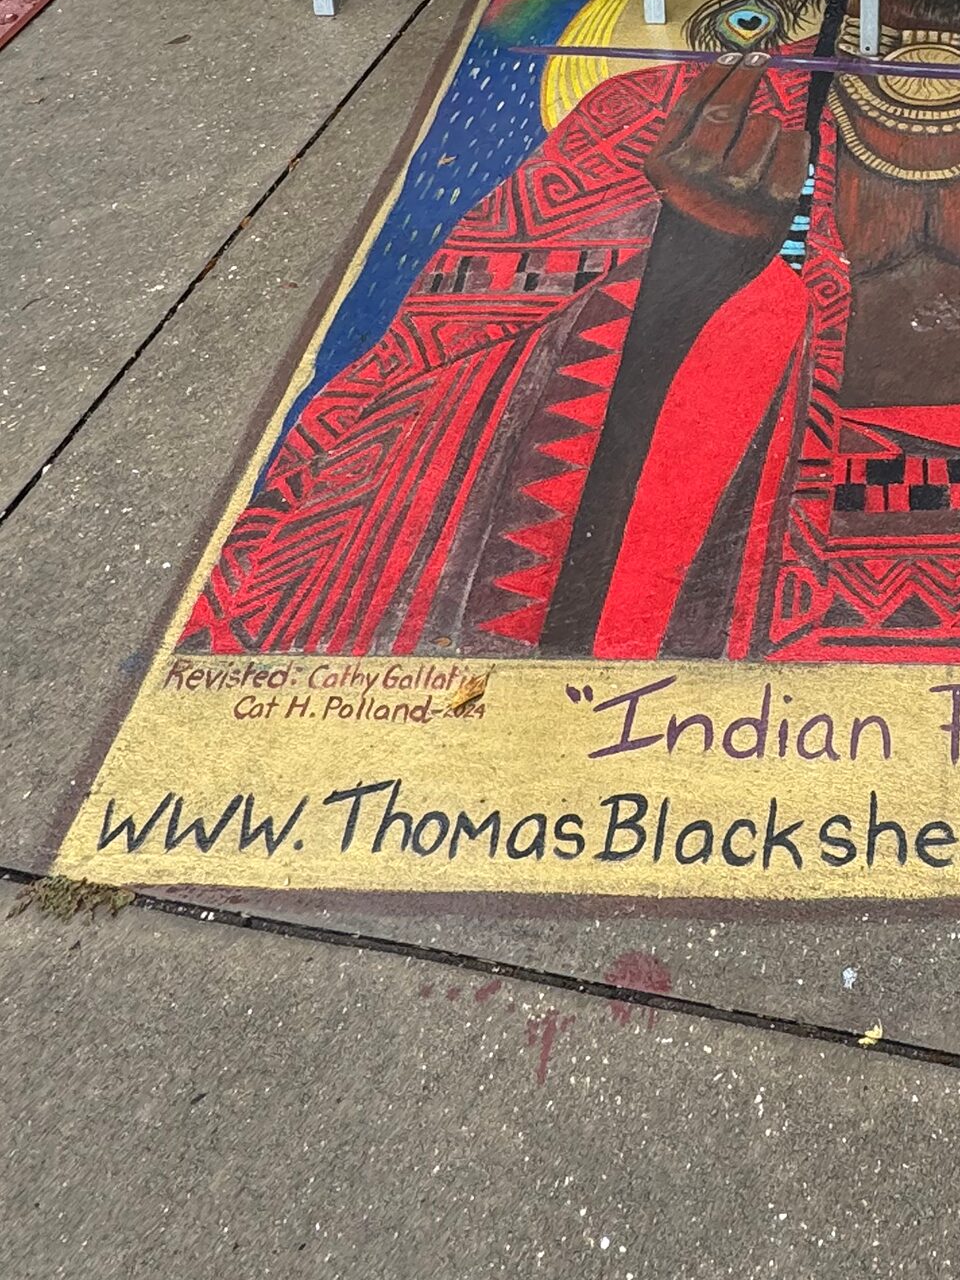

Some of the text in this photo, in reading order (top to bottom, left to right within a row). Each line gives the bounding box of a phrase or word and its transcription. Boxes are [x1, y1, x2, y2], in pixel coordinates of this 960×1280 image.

[308, 660, 380, 699] Cathy
[233, 694, 280, 720] Cat
[284, 694, 316, 719] H.
